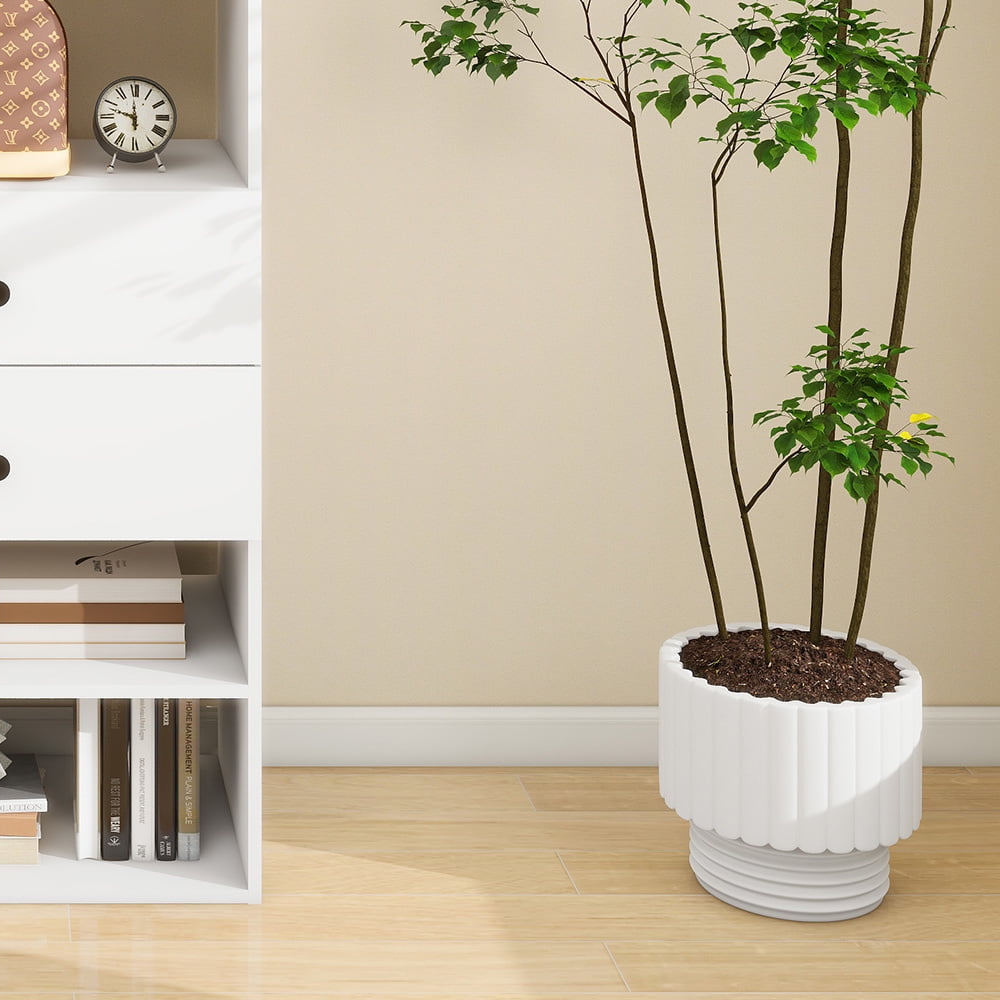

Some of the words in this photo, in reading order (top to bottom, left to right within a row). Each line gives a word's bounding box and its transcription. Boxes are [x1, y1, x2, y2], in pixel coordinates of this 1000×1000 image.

[184, 701, 193, 722] HOME
[184, 723, 193, 773] MANAGEMENT
[184, 776, 193, 794] PLAIN
[110, 798, 120, 807] FOR
[110, 807, 120, 816] THE
[184, 802, 193, 825] SIMPLE
[110, 816, 120, 833] WEARY
